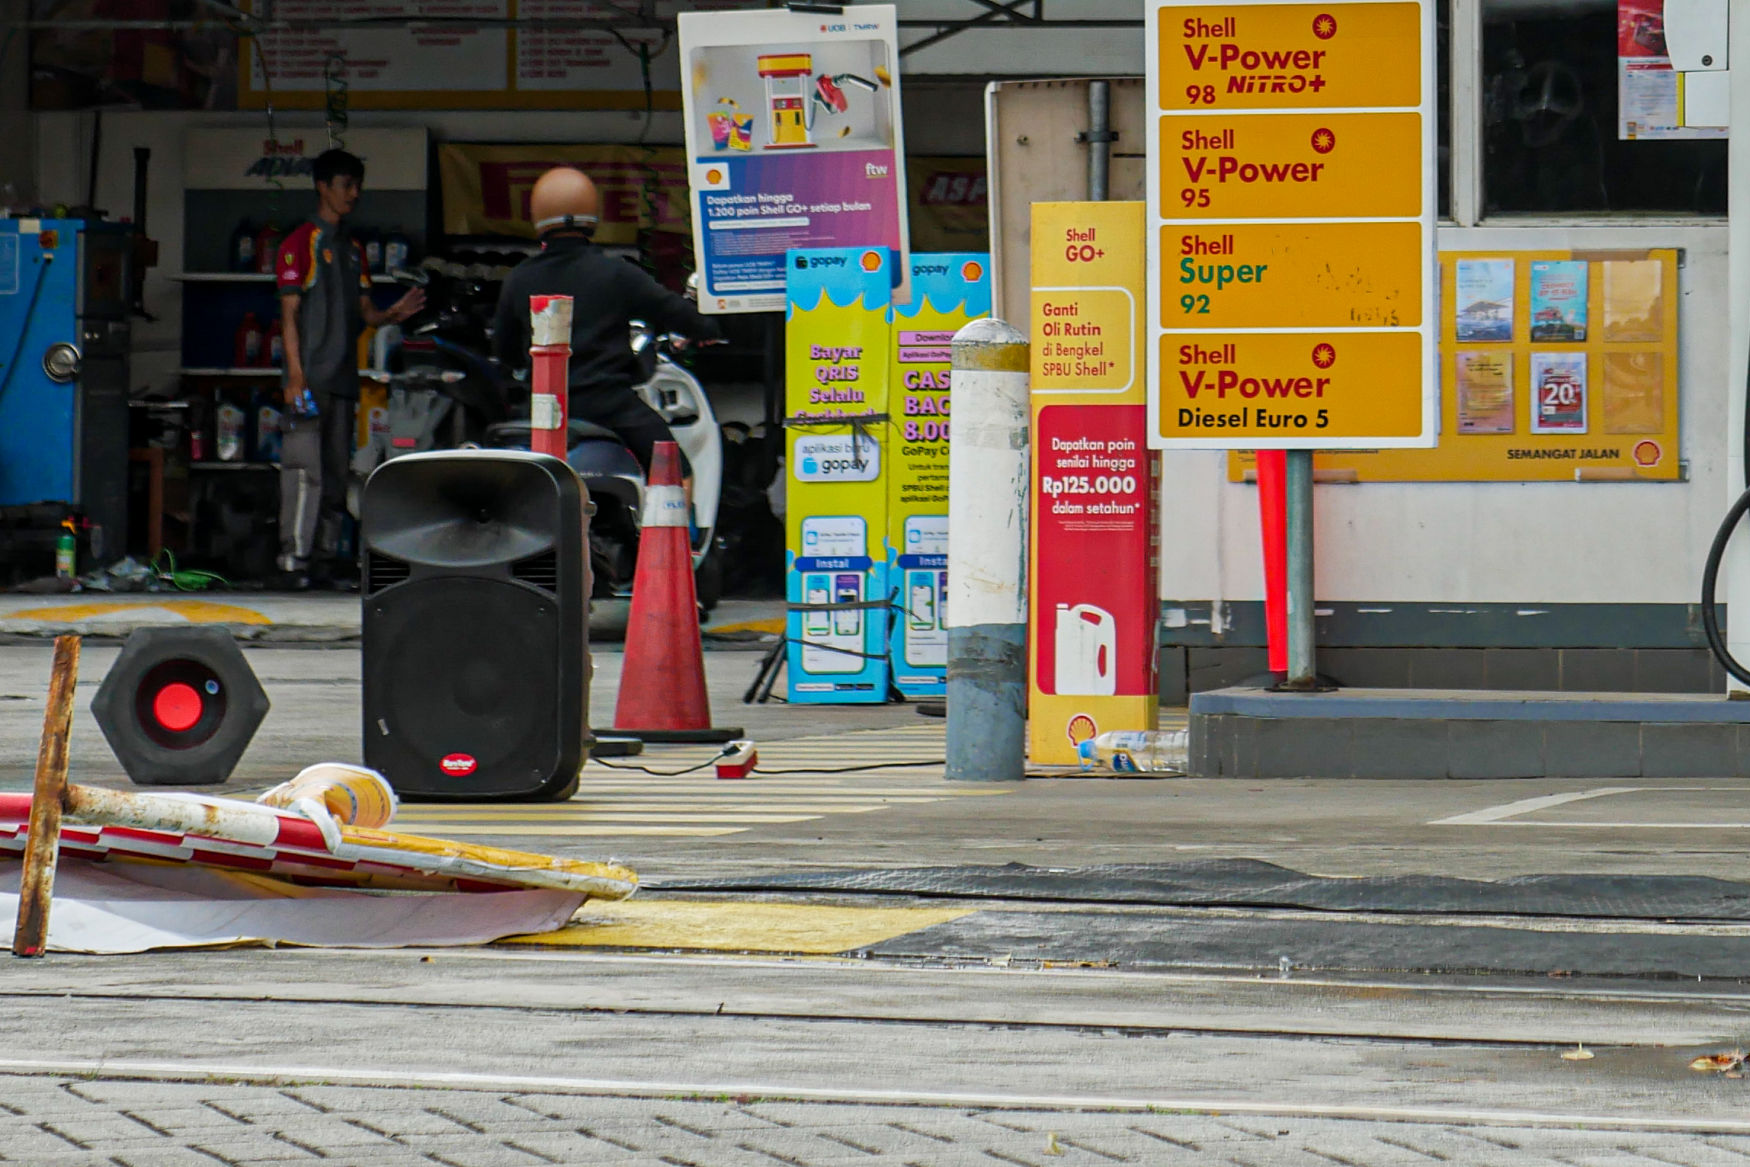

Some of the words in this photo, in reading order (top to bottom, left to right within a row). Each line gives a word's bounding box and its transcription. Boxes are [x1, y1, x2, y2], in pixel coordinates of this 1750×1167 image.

[1183, 17, 1235, 38] Shell
[1183, 43, 1326, 71] V-Power
[1185, 84, 1216, 104] 98
[1182, 129, 1234, 150] Shell
[1181, 156, 1324, 182] V-Power
[706, 194, 757, 206] Dapatkan
[758, 193, 794, 204] hingga
[1181, 188, 1210, 208] 95
[760, 204, 785, 215] Shell
[810, 203, 841, 213] setiap
[842, 201, 872, 211] bulan
[1066, 228, 1096, 242] Shell
[1065, 244, 1105, 262] GO+
[1180, 234, 1234, 255] Shell
[810, 255, 848, 268] gopay
[912, 263, 949, 276] gopay
[1179, 257, 1268, 291] Super
[1042, 302, 1078, 317] Ganti
[1180, 294, 1211, 314] 92
[1042, 322, 1061, 336] Oli
[1064, 322, 1101, 337] Rutin
[810, 344, 862, 363] Bayar
[1042, 342, 1053, 356] di
[1056, 341, 1104, 360] Bengkel
[1179, 343, 1236, 365] Shell
[815, 365, 859, 383] QRIS
[1042, 362, 1071, 376] SPBU
[903, 370, 950, 390] CAS
[1179, 370, 1331, 399] V-Power
[809, 387, 865, 404] Selalu
[903, 395, 950, 415] BAC
[1178, 407, 1248, 428] Diesel
[1255, 409, 1308, 428] Euro
[1315, 409, 1329, 428] 5
[802, 442, 843, 456] aplikasi
[844, 442, 870, 454] bru
[902, 446, 938, 458] GoPay
[1051, 436, 1105, 454] Dapatkan
[1107, 438, 1135, 454] poin
[1056, 454, 1089, 468] senilai
[1092, 454, 1135, 472] hingga
[1507, 449, 1577, 460] SEMANGAT
[1578, 449, 1620, 460] JALAN
[822, 457, 869, 474] gopay
[1042, 476, 1136, 498] Rp125.000
[1052, 500, 1084, 514] dalam
[919, 557, 948, 566] Insta
